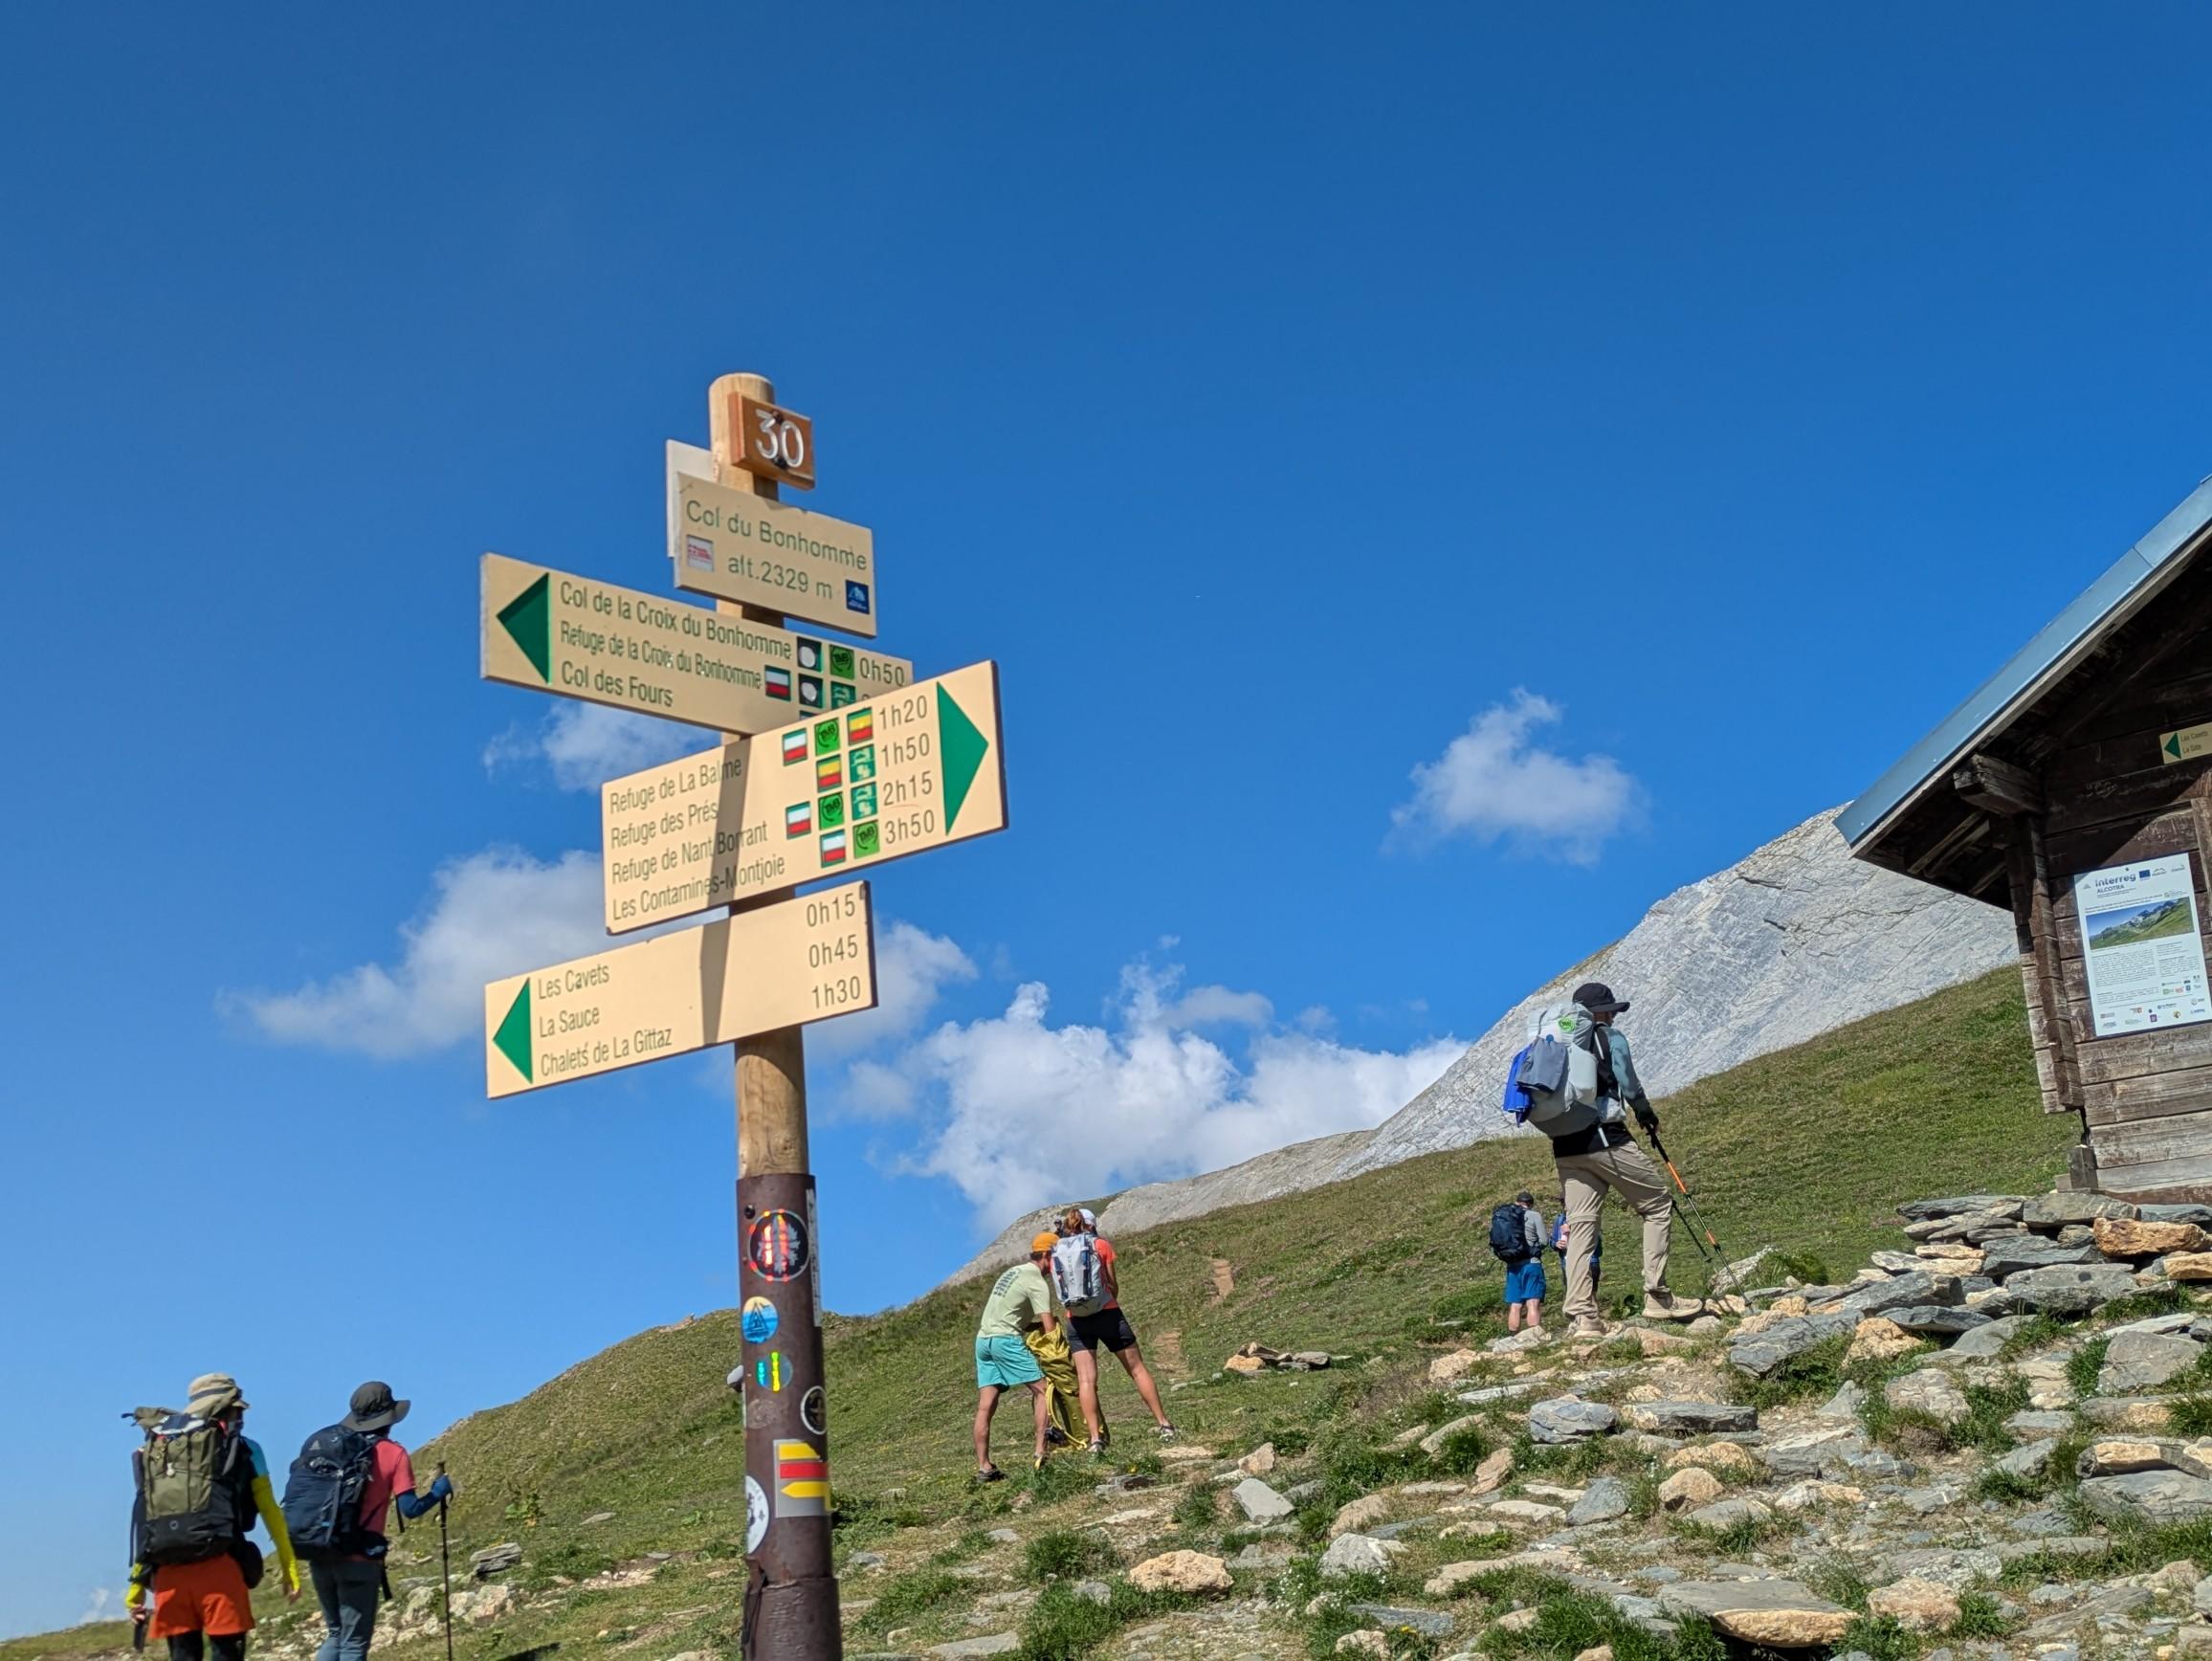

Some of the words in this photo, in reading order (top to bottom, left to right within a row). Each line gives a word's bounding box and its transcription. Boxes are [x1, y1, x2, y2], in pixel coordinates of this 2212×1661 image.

[756, 409, 804, 468] 30
[686, 500, 719, 528] Col
[727, 514, 751, 537] du
[760, 520, 867, 570] Bonhomme
[728, 555, 808, 593] alt.2329
[816, 581, 832, 599] m
[561, 581, 587, 609] Col
[593, 590, 612, 615] de
[618, 595, 631, 619] la
[636, 601, 677, 631] Croix
[682, 613, 700, 637] du
[706, 618, 791, 659] Bonhomme
[861, 657, 905, 687] 0h50
[561, 620, 605, 655] Refuge
[609, 632, 624, 656] de
[628, 636, 638, 660] la
[642, 640, 674, 668] Croix
[676, 649, 692, 673] du
[696, 653, 763, 689] Bonhomme
[562, 660, 588, 687] Col
[594, 670, 623, 696] des
[629, 676, 674, 707] Fours
[610, 785, 654, 814] Refuge
[659, 777, 675, 799] de
[679, 771, 696, 793] La
[699, 759, 741, 786] Balme
[879, 695, 927, 730] 1h20
[611, 821, 656, 849] Refuge
[660, 812, 684, 835] des
[689, 800, 719, 826] Prés
[881, 733, 930, 767] 1h50
[612, 854, 657, 884] Refuge
[661, 848, 677, 871] de
[682, 837, 714, 865] Nant
[719, 821, 767, 854] Borrant
[883, 770, 933, 807] 2h15
[613, 898, 636, 920] Les
[640, 853, 785, 913] Contamines-Montjoie
[885, 809, 934, 844] 3h50
[538, 979, 561, 1000] Les
[565, 963, 609, 992] Cavets
[807, 893, 855, 927] 0h15
[540, 1016, 555, 1038] La
[559, 1007, 600, 1033] Sauce
[809, 934, 857, 968] 0h45
[593, 1041, 608, 1063] de
[613, 1037, 630, 1058] La
[634, 1028, 673, 1053] Gittaz
[811, 976, 860, 1008] 1h30
